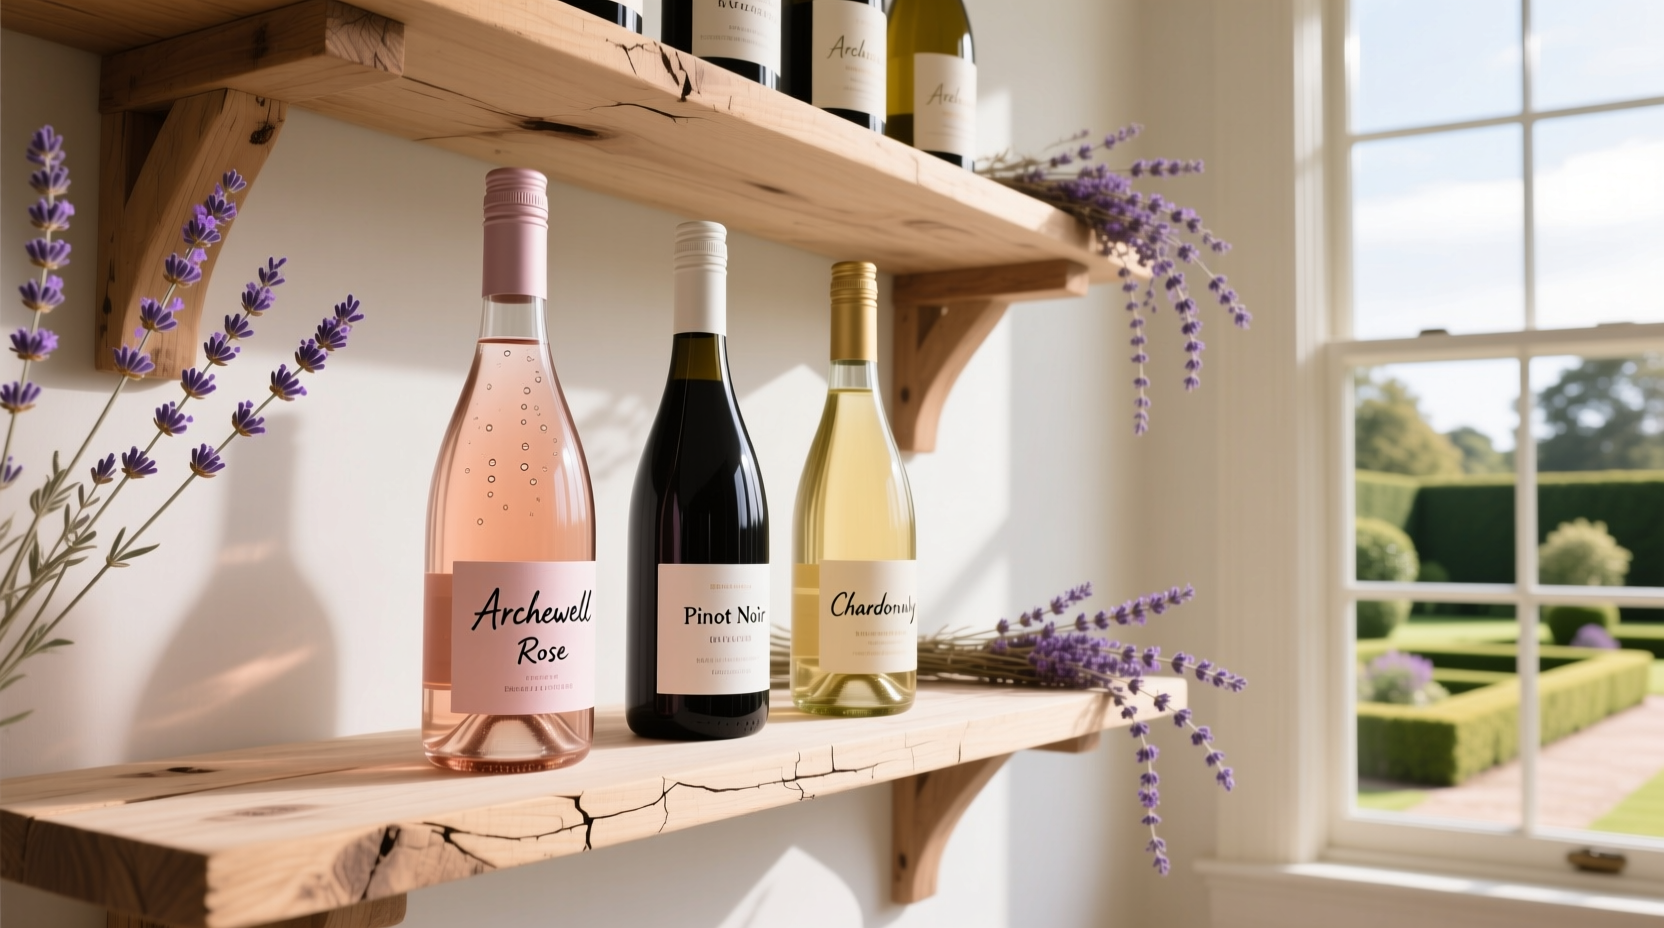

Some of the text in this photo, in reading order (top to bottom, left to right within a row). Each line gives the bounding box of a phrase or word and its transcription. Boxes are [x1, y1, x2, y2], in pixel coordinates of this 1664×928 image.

[471, 587, 592, 631] Archewell
[683, 605, 766, 625] Pinot Noir
[517, 636, 569, 665] Rose
